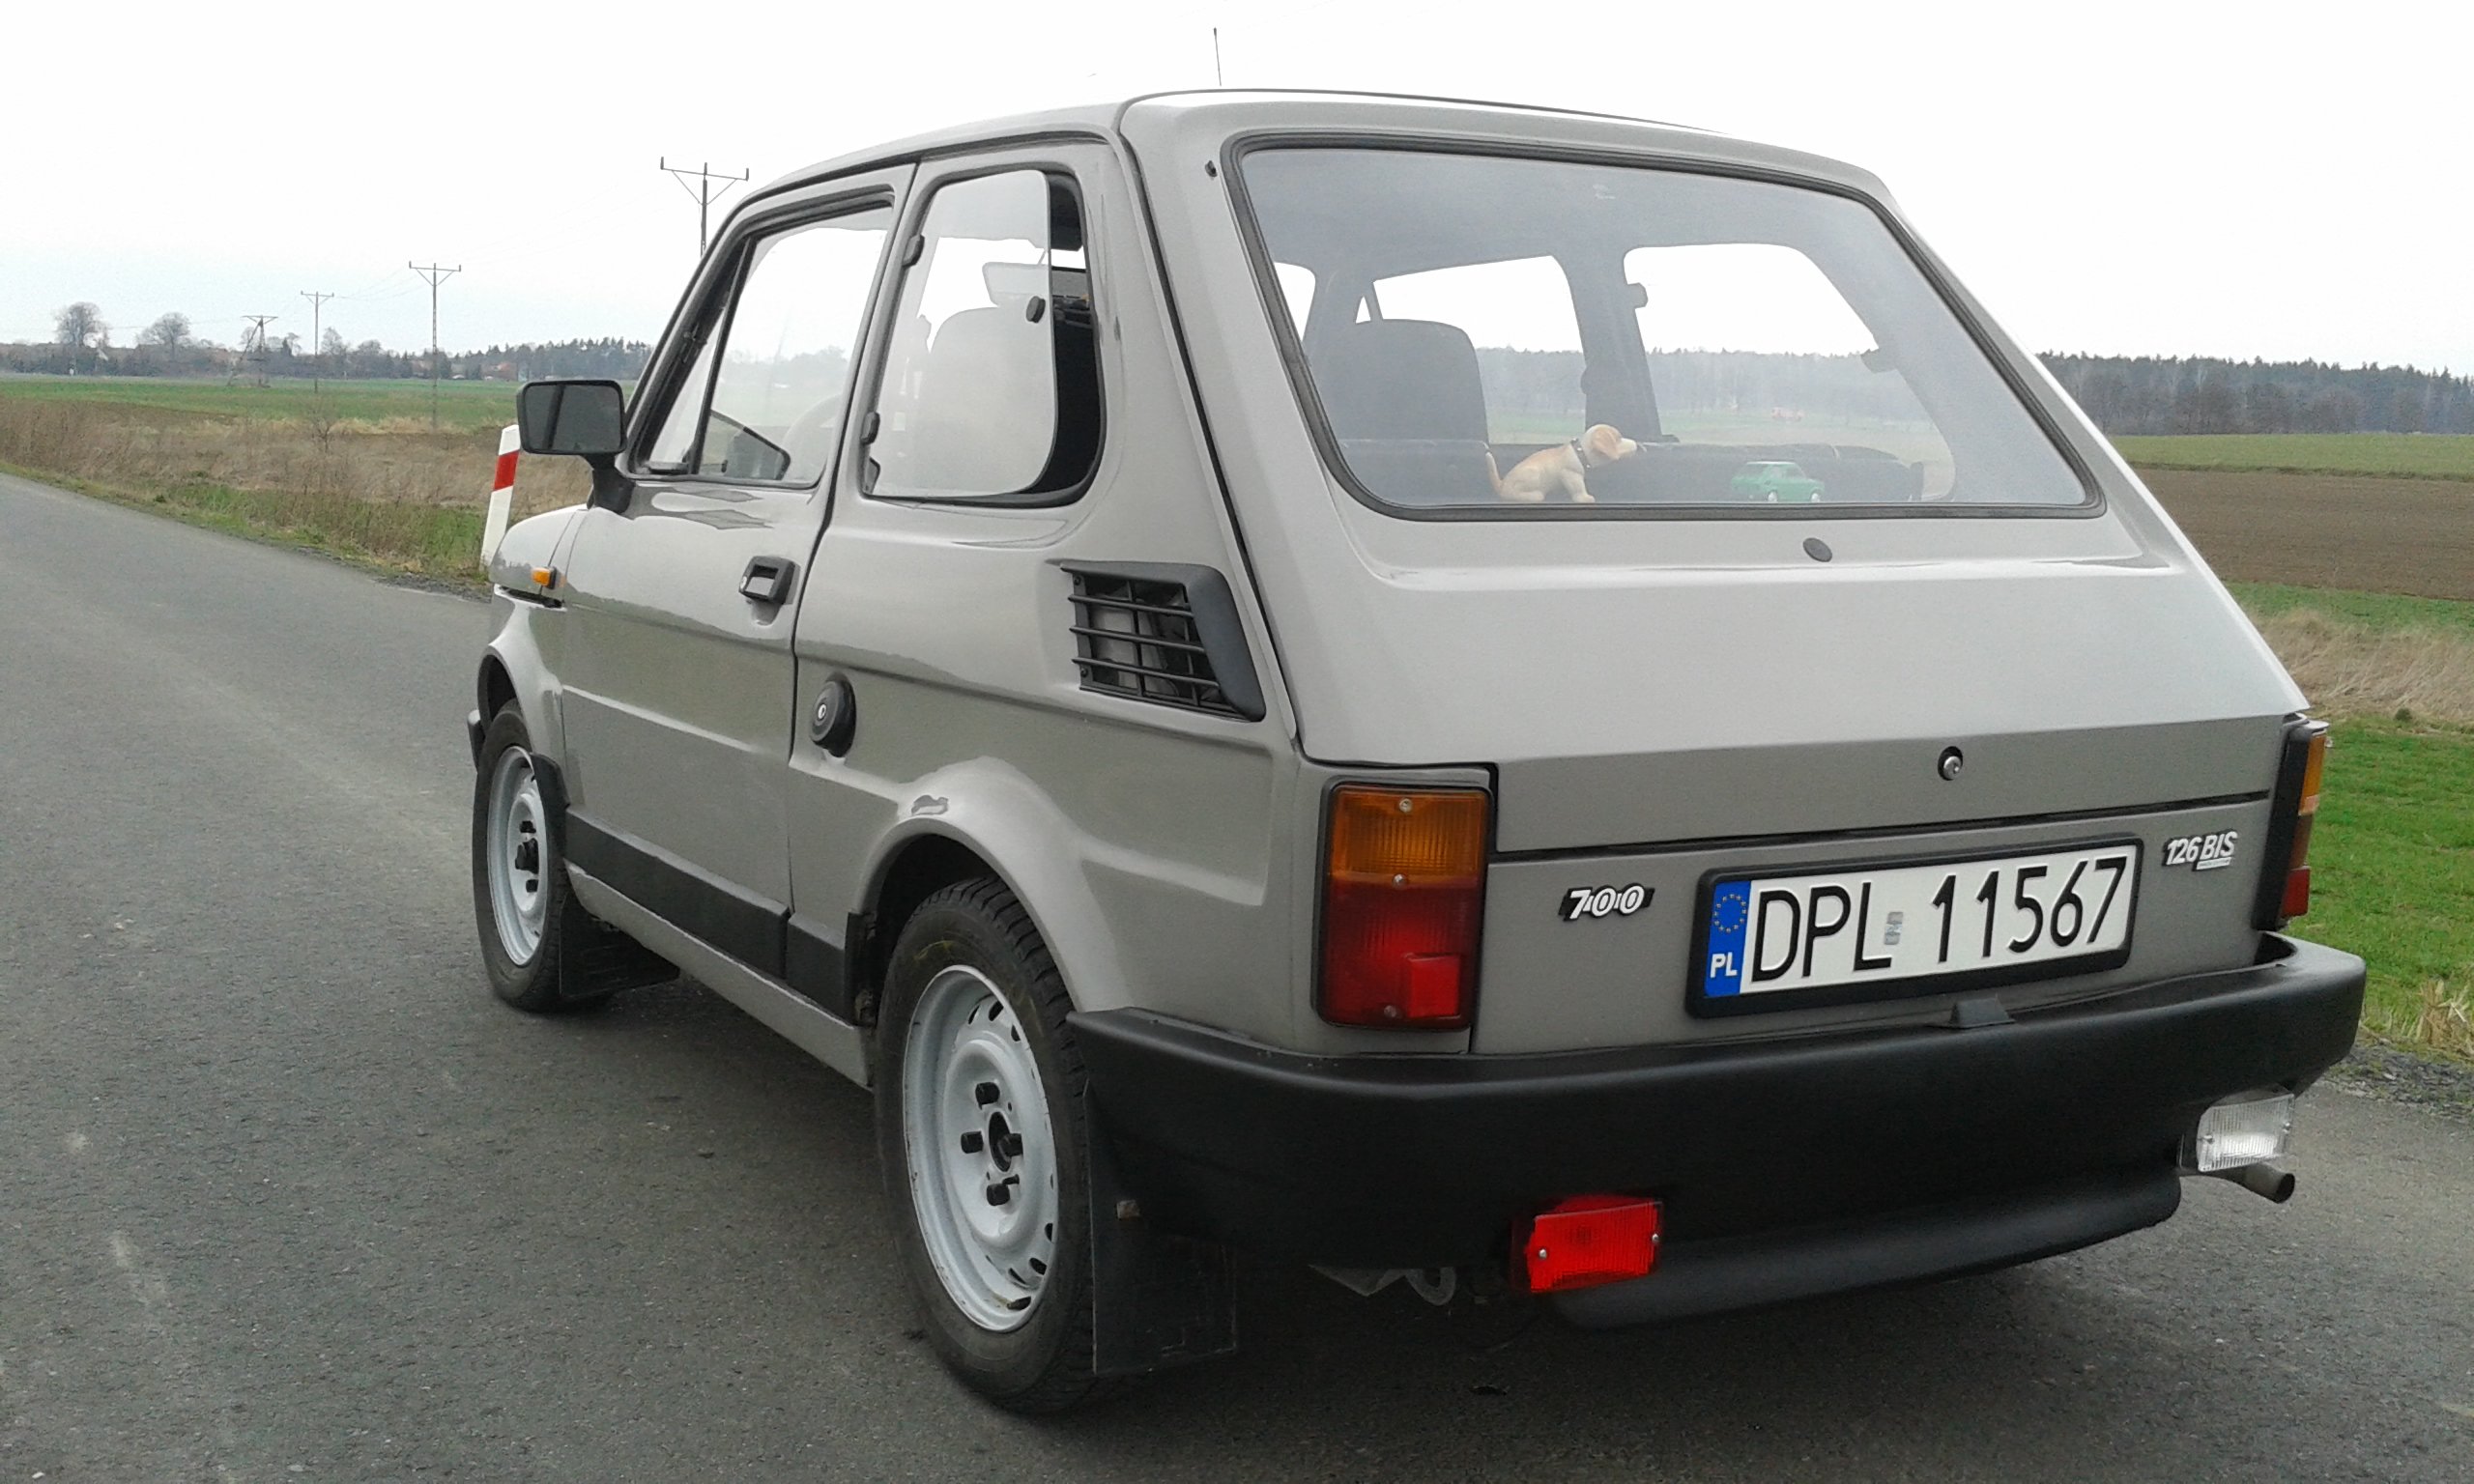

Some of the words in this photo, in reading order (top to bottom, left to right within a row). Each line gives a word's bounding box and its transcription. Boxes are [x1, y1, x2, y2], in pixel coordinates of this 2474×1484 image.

[1568, 885, 1645, 920] 700
[1751, 881, 1892, 983] DPL
[1932, 856, 2128, 963] 11567
[1711, 952, 1738, 978] PL
